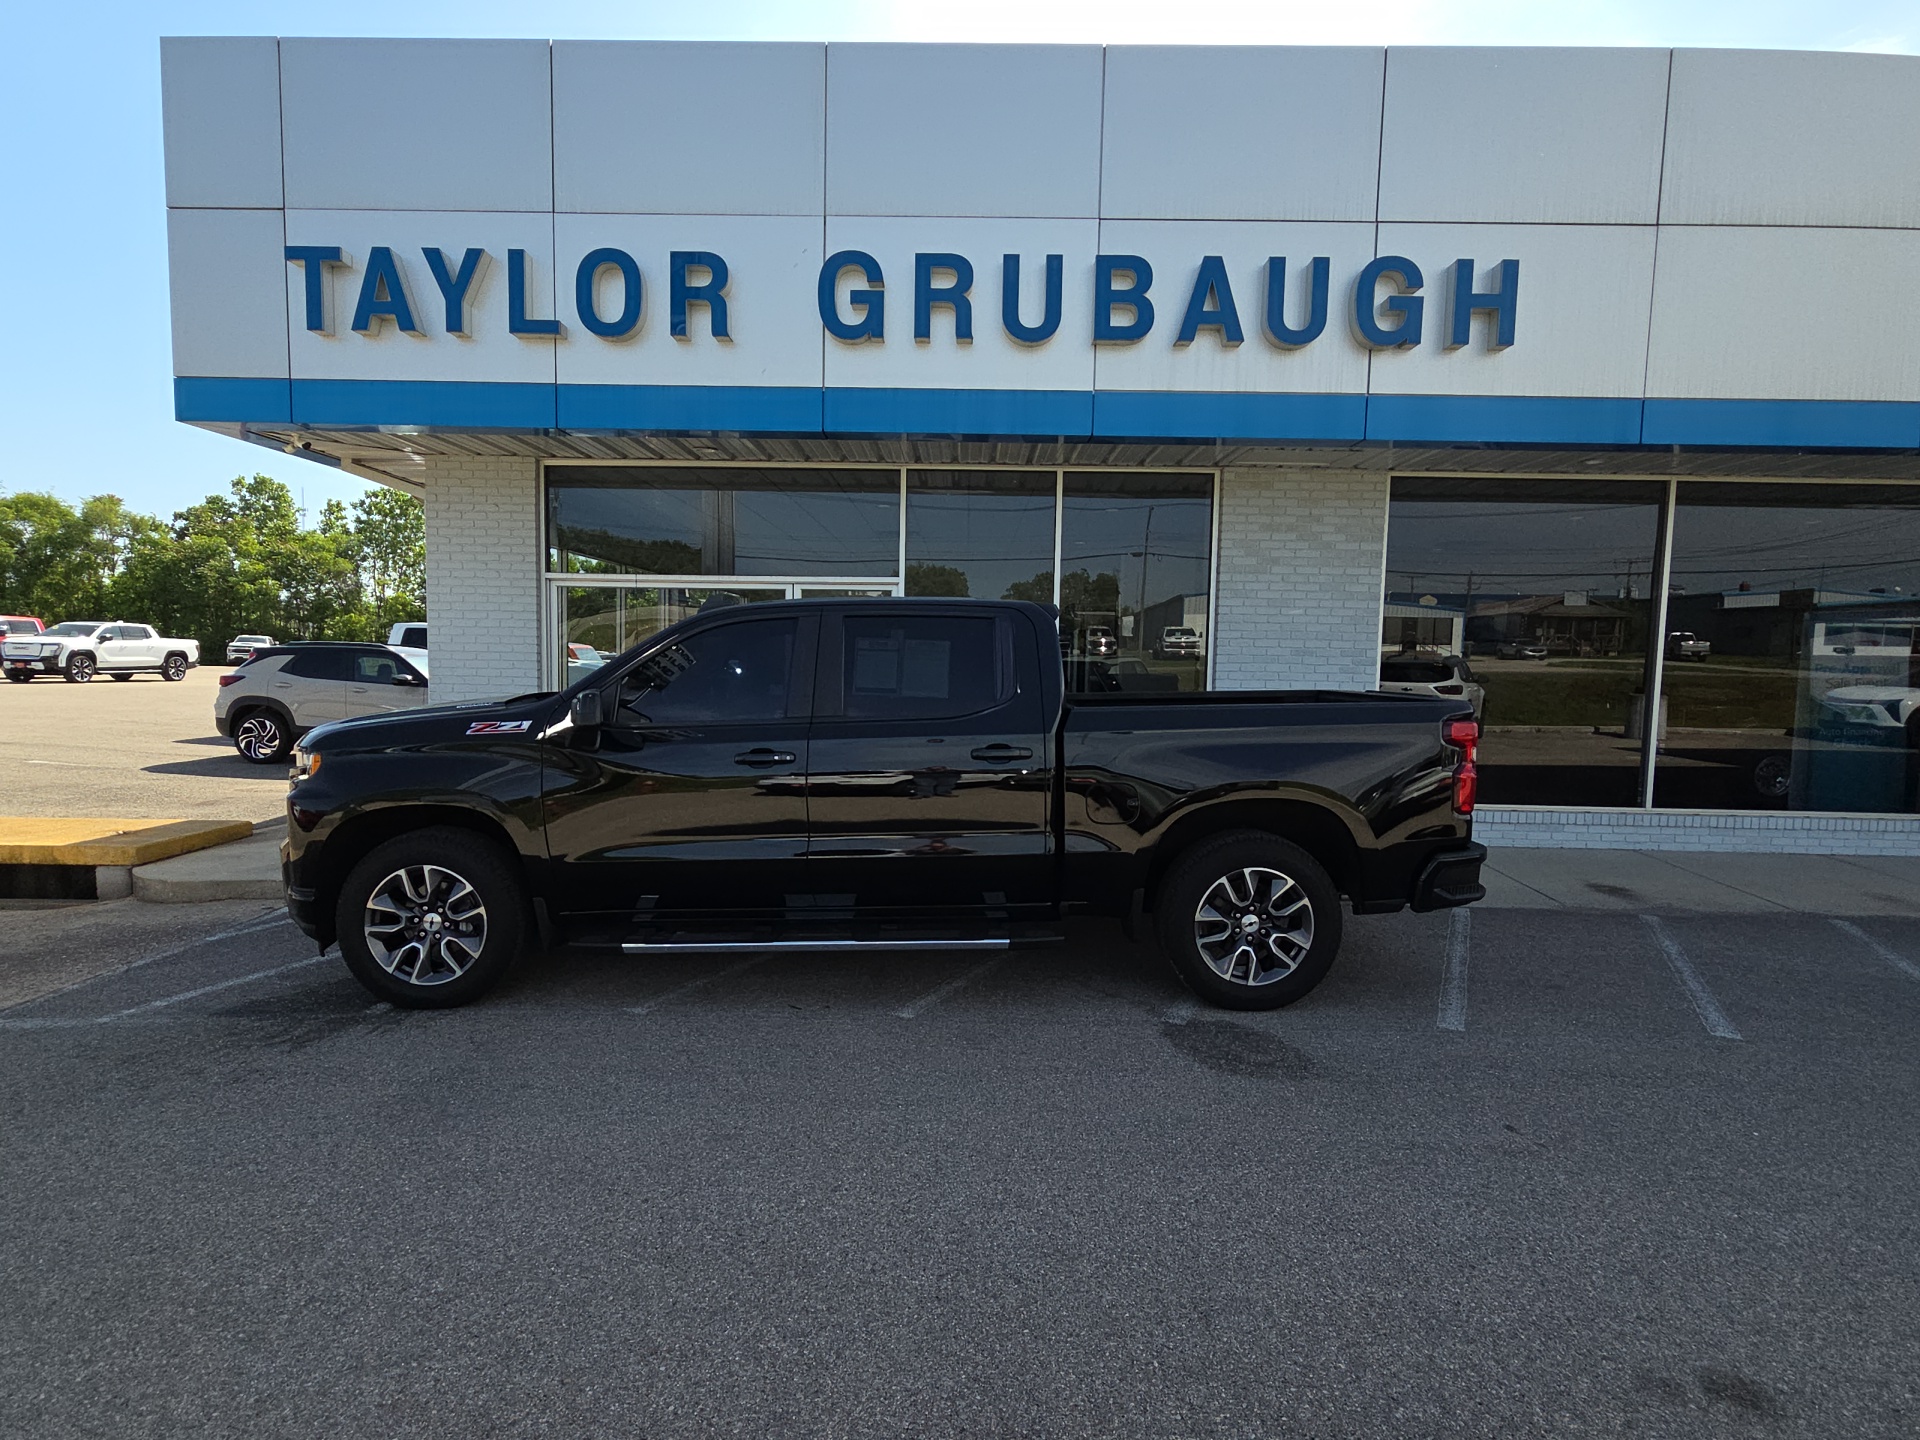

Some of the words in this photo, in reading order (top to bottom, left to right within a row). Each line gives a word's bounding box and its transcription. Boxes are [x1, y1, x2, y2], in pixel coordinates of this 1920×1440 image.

[285, 246, 733, 342] TAYLOR
[818, 250, 1520, 350] GRUBAUGH
[466, 720, 533, 735] Z71
